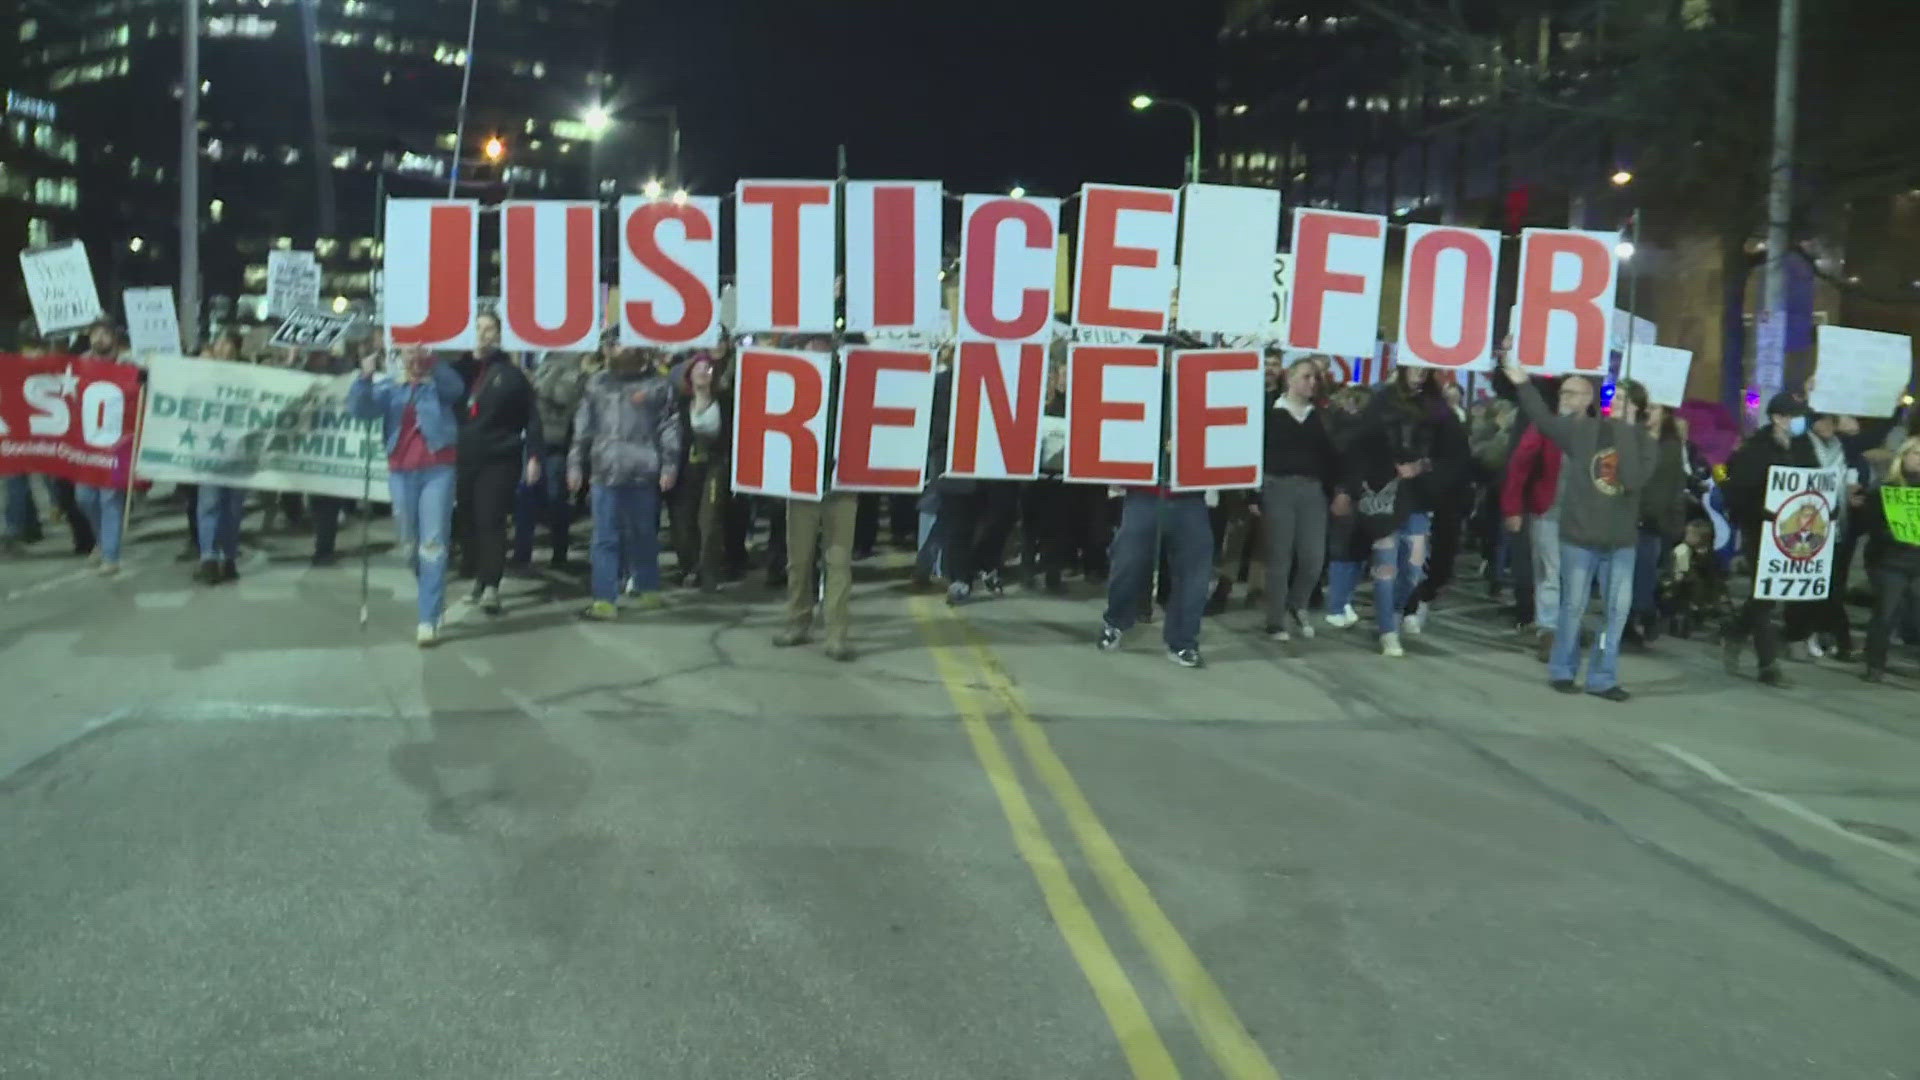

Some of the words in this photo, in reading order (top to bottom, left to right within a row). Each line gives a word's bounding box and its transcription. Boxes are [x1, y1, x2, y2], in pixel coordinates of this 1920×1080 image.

[392, 186, 1174, 347] JUSTICE
[1290, 214, 1609, 369] FOR
[0, 373, 125, 448] SO
[152, 393, 299, 430] DEFEND
[737, 343, 1259, 493] RENEE
[1772, 470, 1799, 492] NO
[1768, 560, 1824, 574] SINCE
[1760, 577, 1826, 597] 1776
